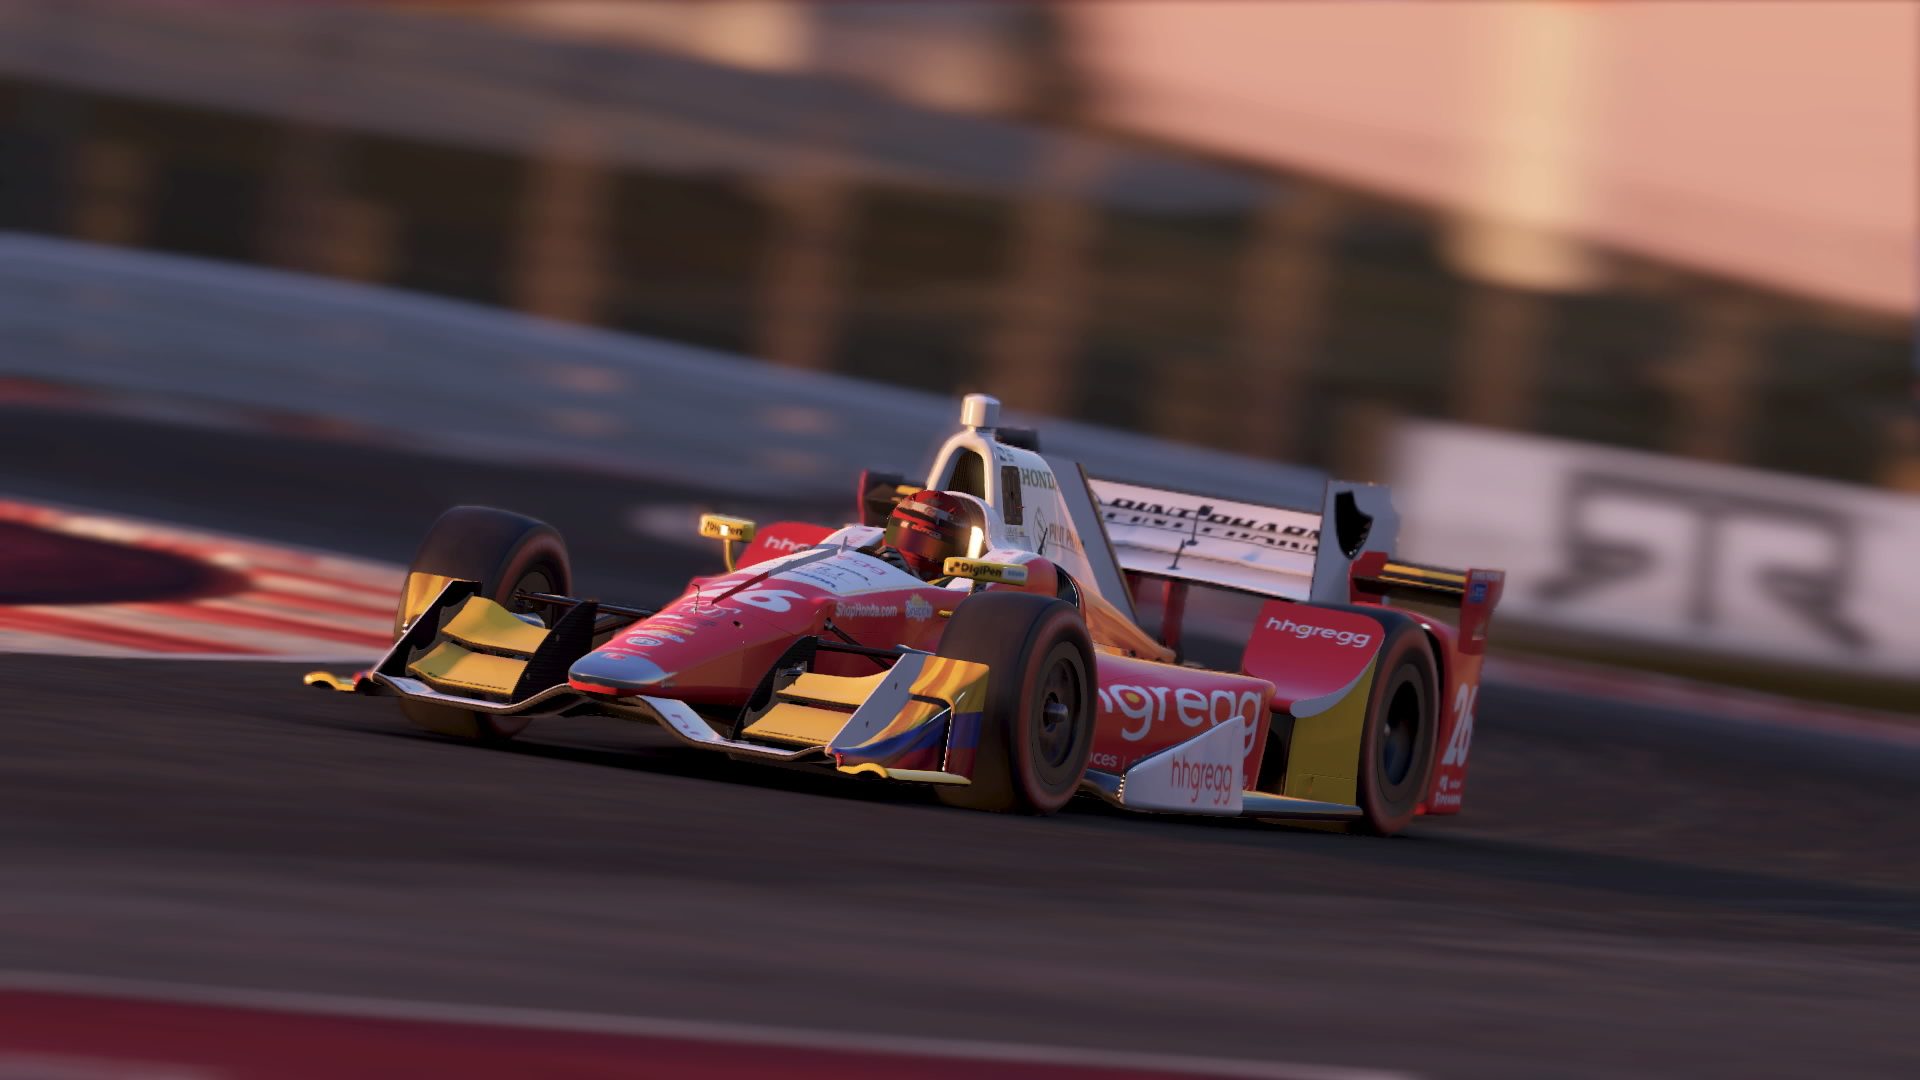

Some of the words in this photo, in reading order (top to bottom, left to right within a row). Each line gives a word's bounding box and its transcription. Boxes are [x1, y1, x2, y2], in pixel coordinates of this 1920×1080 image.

[961, 562, 1002, 578] DigiPen
[686, 579, 807, 613] 26
[836, 601, 898, 620] ShopHonda.com
[1265, 616, 1371, 649] hhgregg
[1098, 684, 1262, 760] gregg
[1441, 682, 1478, 768] 26
[1171, 753, 1233, 806] hhgregg
